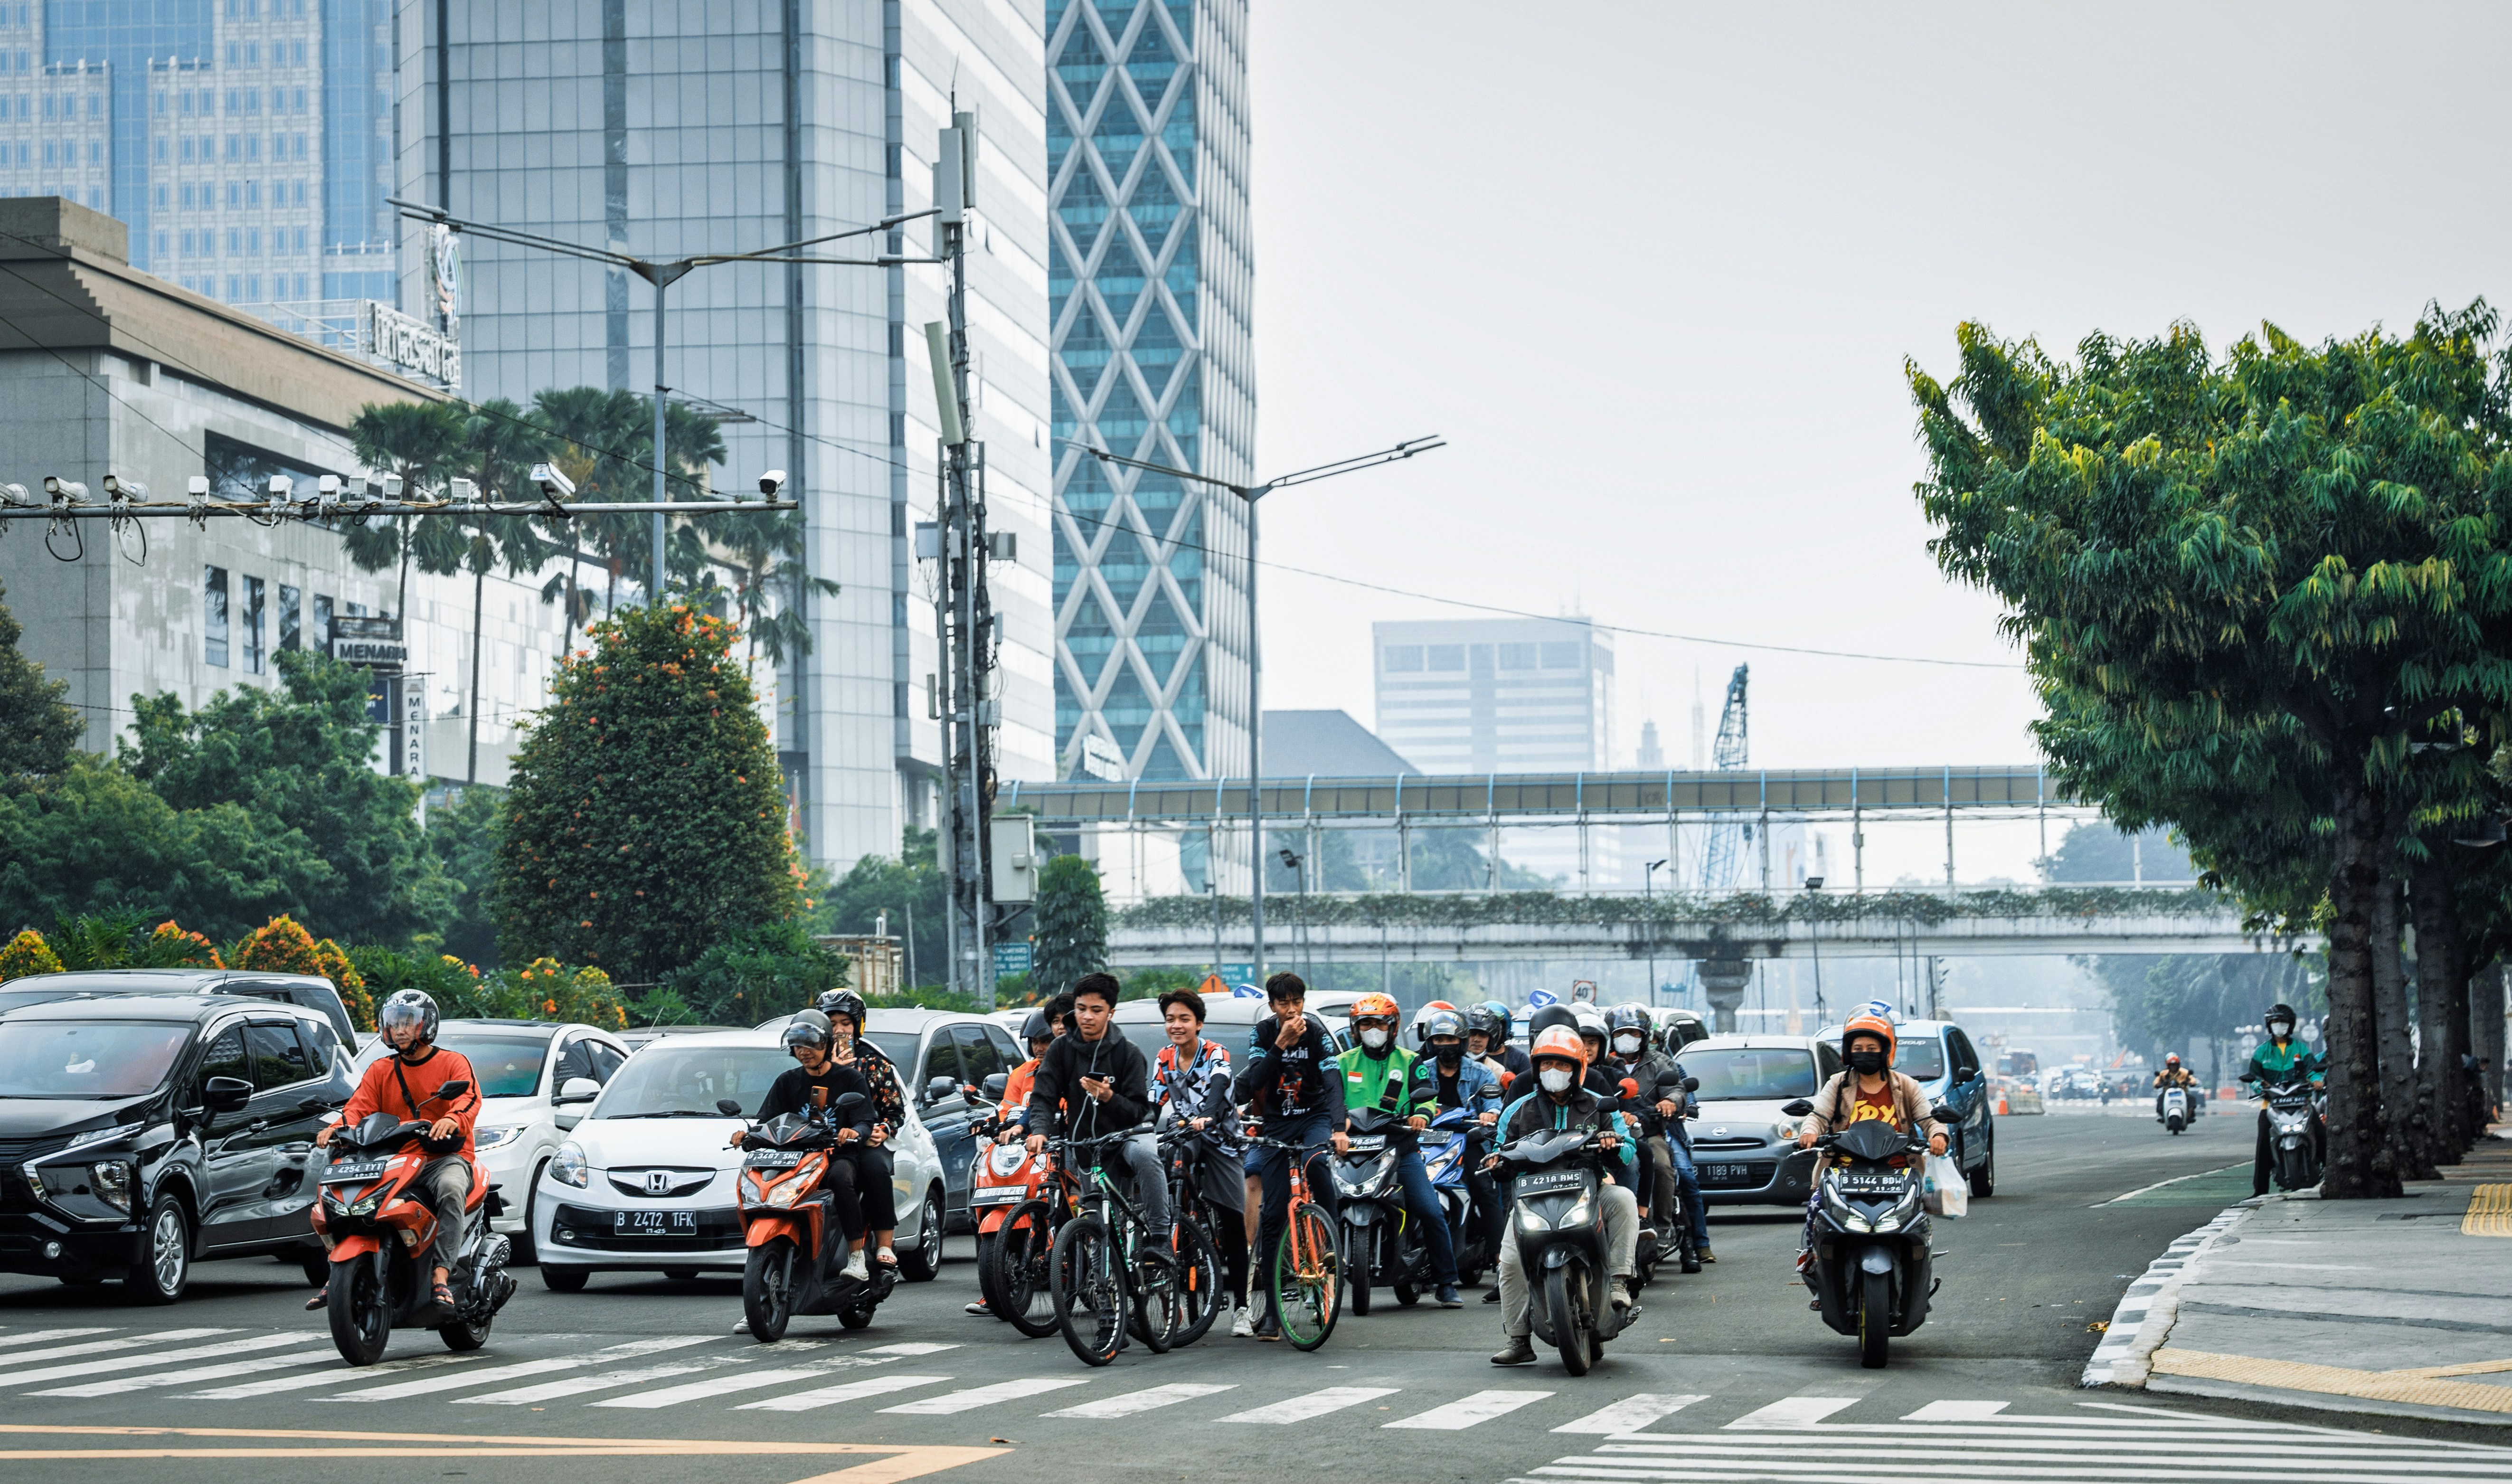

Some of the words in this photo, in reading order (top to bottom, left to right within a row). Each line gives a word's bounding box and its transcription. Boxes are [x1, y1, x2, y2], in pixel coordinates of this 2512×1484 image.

[408, 697, 420, 776] MENARA
[1575, 987, 1588, 998] 40
[326, 1167, 333, 1175] B
[338, 1165, 361, 1173] 4254
[365, 1163, 382, 1171] TYT
[1707, 1165, 1728, 1176] 1189
[1730, 1164, 1747, 1175] PVH
[1521, 1179, 1527, 1187] B
[1533, 1176, 1557, 1185] 4218
[1560, 1173, 1580, 1182] BMS
[1842, 1176, 1849, 1184] B
[1852, 1176, 1877, 1184] 5144
[1882, 1176, 1902, 1184] BDW
[616, 1212, 625, 1226] B
[634, 1212, 663, 1227] 2472
[671, 1212, 695, 1227] TFK
